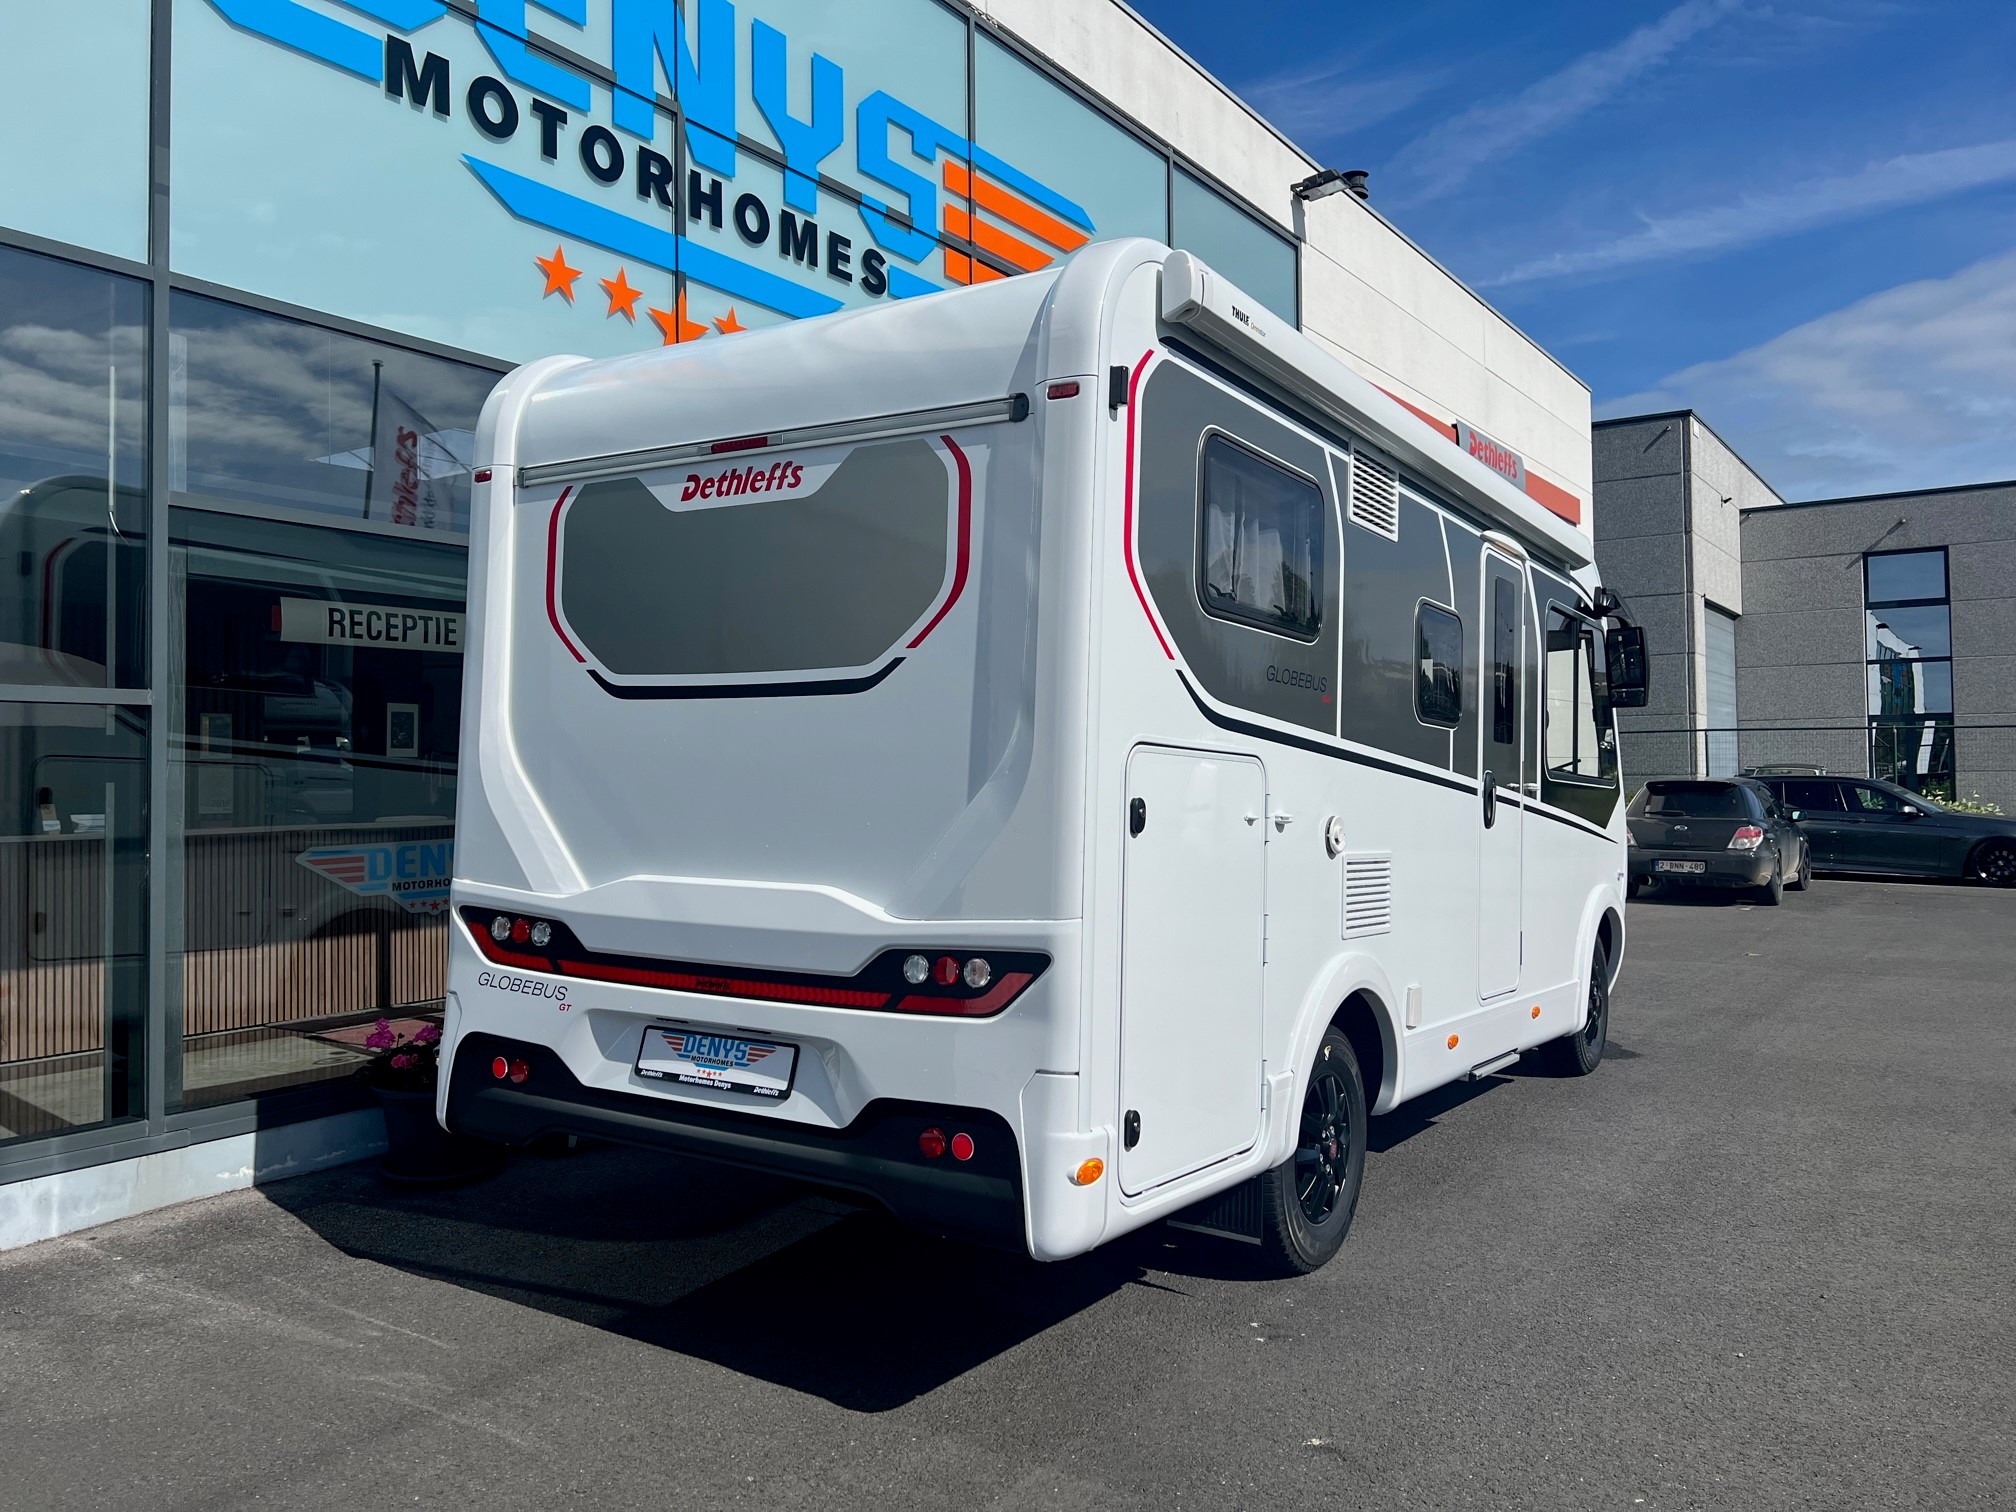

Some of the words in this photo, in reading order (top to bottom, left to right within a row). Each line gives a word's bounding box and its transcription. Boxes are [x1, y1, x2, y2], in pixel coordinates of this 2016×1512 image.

[385, 33, 888, 297] MOTORHOMES
[1231, 305, 1250, 323] THULE
[1469, 430, 1518, 480] Dethleffs
[681, 460, 804, 502] Dethleffs
[328, 607, 457, 646] RECEPTIE
[1266, 665, 1328, 692] GLOBEBUS
[368, 843, 454, 881] DEN
[478, 972, 568, 1001] GLOBEBUS
[559, 1003, 572, 1012] GT
[683, 1035, 750, 1062] DENYS
[691, 1055, 734, 1067] MOTORHOMES
[641, 1069, 663, 1078] Dethleffs
[679, 1074, 713, 1086] Motorhomes
[714, 1080, 731, 1090] Denys
[753, 1086, 779, 1097] Dethleffs
